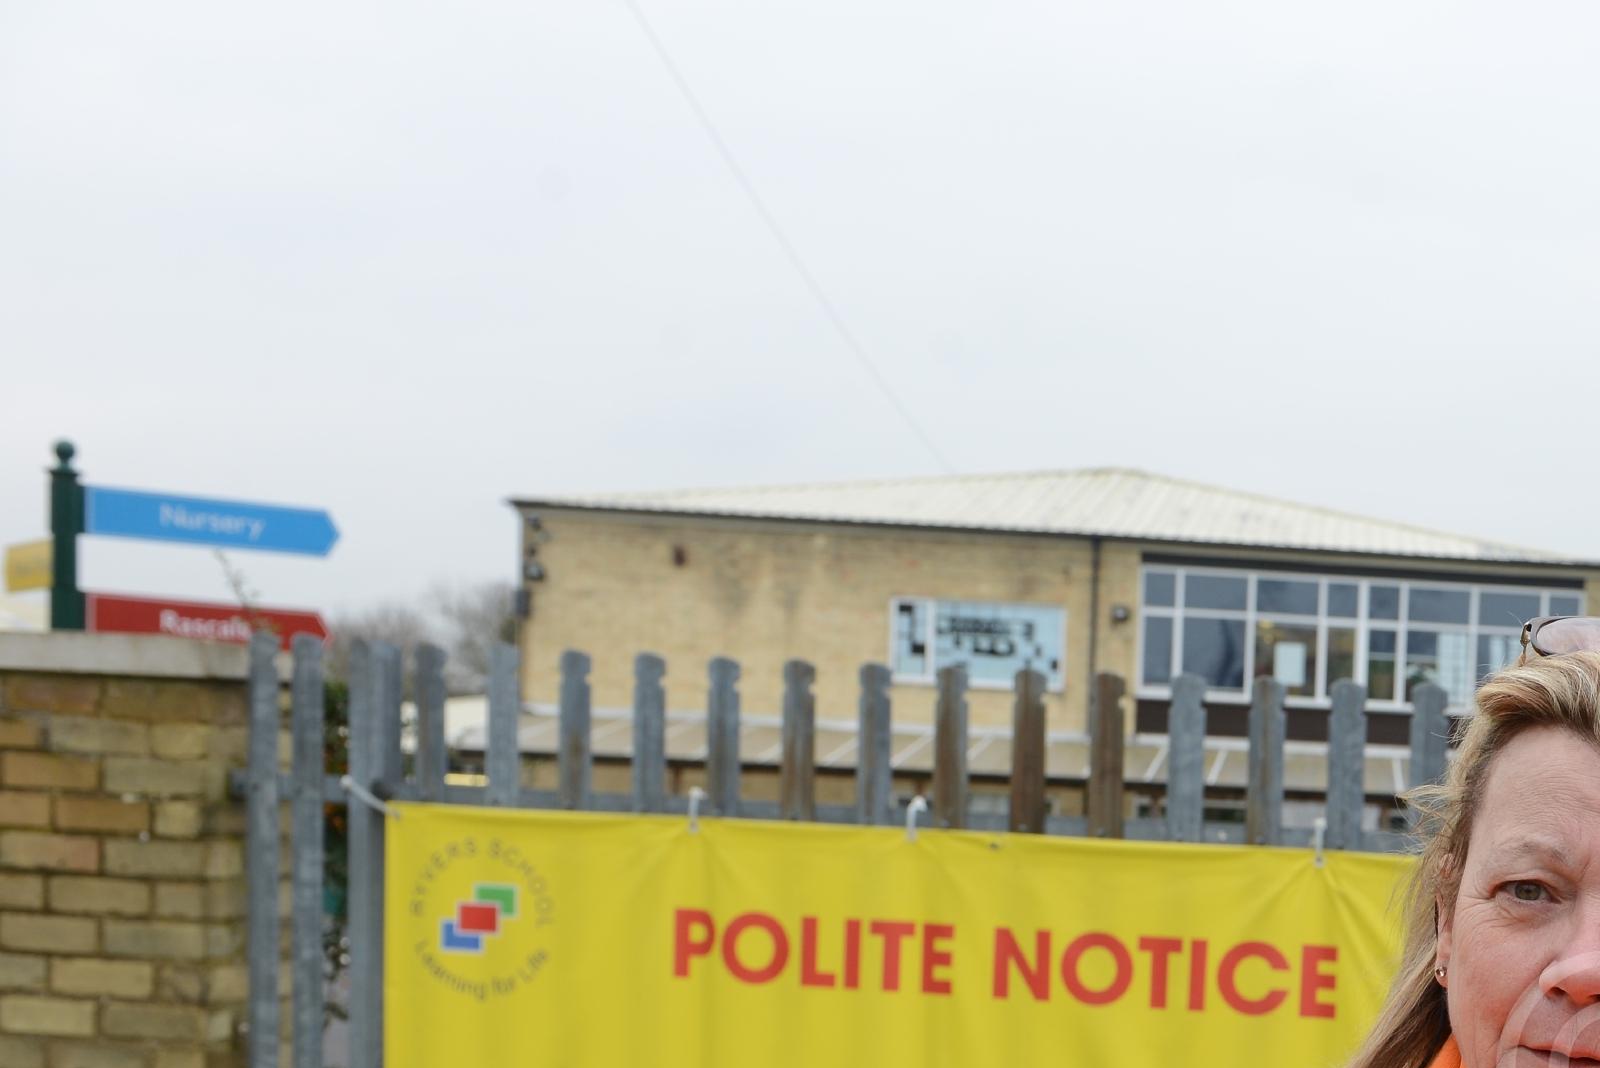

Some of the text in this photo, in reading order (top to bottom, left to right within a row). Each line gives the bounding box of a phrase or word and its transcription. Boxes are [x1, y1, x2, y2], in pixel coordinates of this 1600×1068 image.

[159, 504, 265, 539] Nursery
[488, 838, 553, 927] SCHOOL
[673, 907, 1338, 1020] POLITE NOTICE
